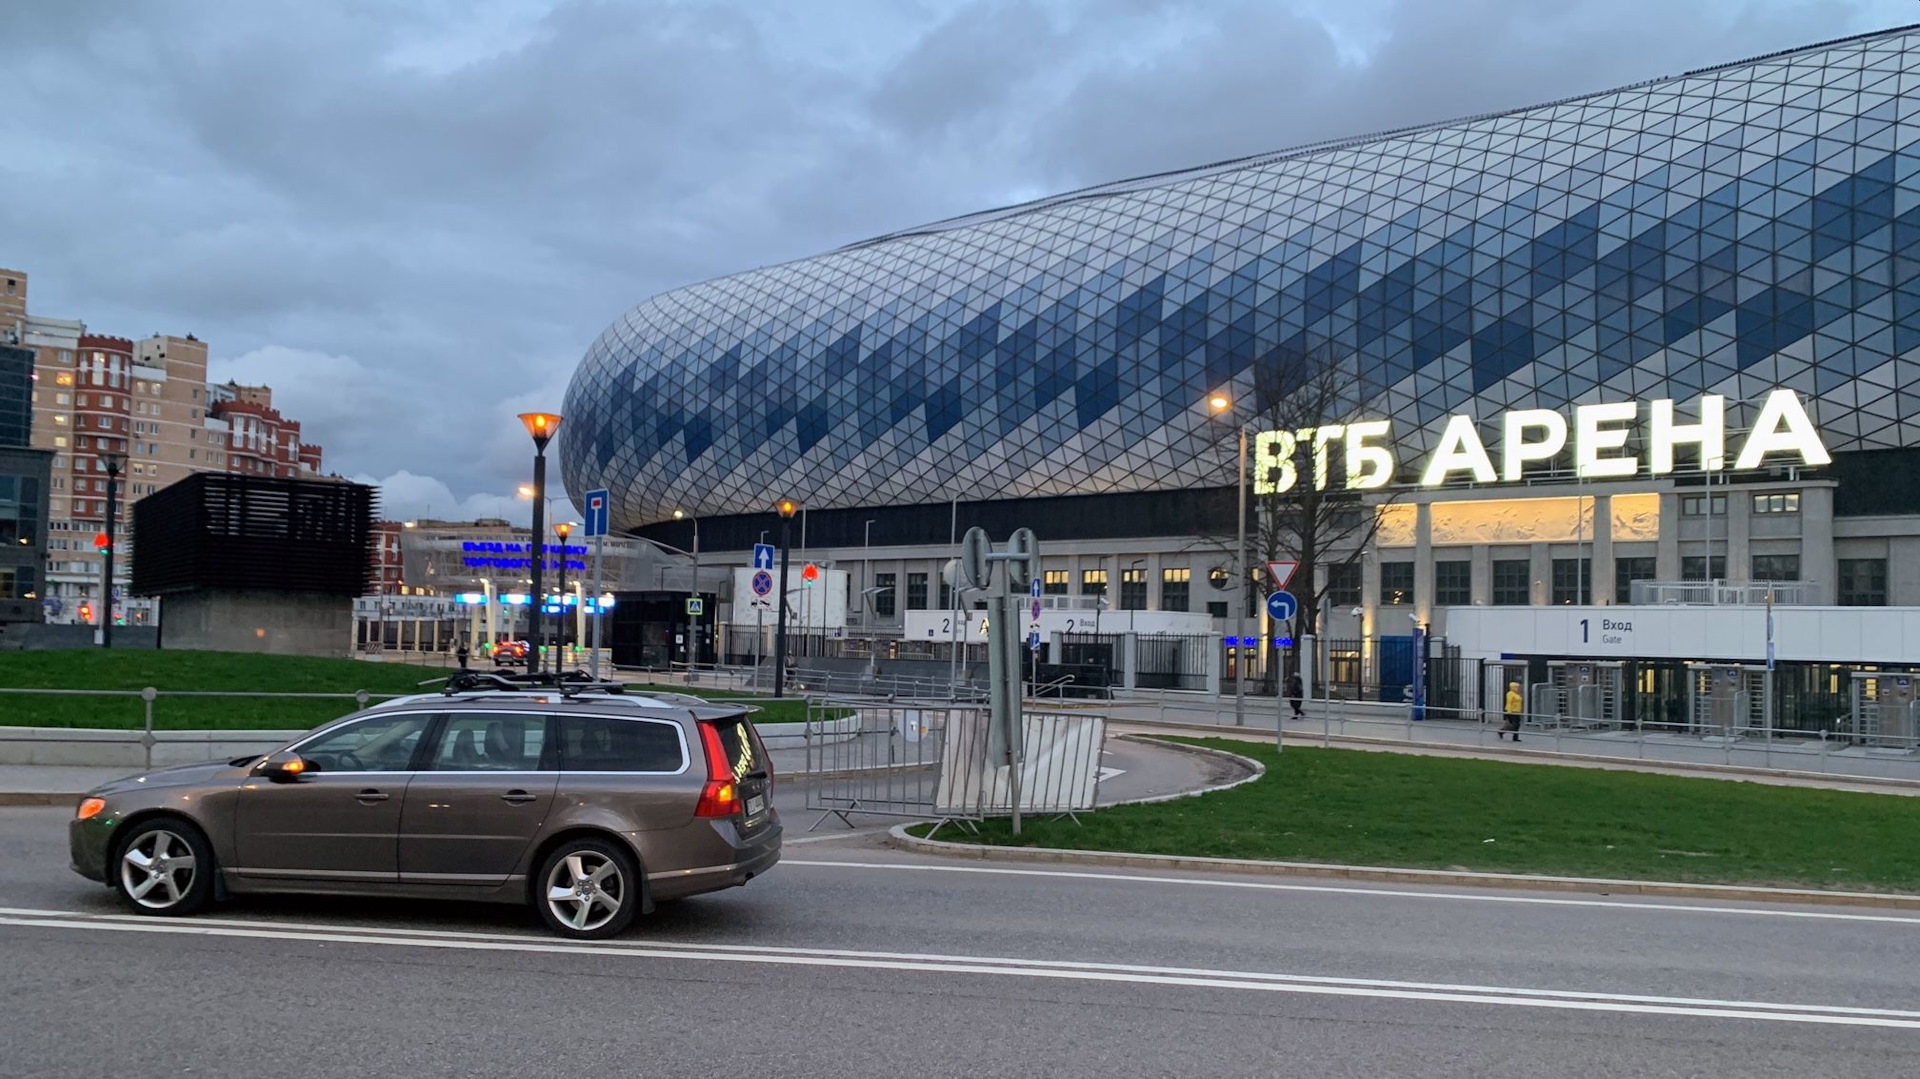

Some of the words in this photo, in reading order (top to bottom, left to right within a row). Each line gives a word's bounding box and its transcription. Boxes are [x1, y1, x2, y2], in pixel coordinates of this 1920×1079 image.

[1253, 420, 1395, 495] ВТБ
[1421, 389, 1832, 486] АРЕНА
[463, 542, 503, 553] ВЪЕЗД
[506, 543, 522, 552] НА
[942, 618, 950, 633] 2
[1066, 619, 1075, 634] 2
[1580, 619, 1589, 643] 1
[1603, 619, 1632, 632] Вход
[1603, 634, 1622, 644] Gate
